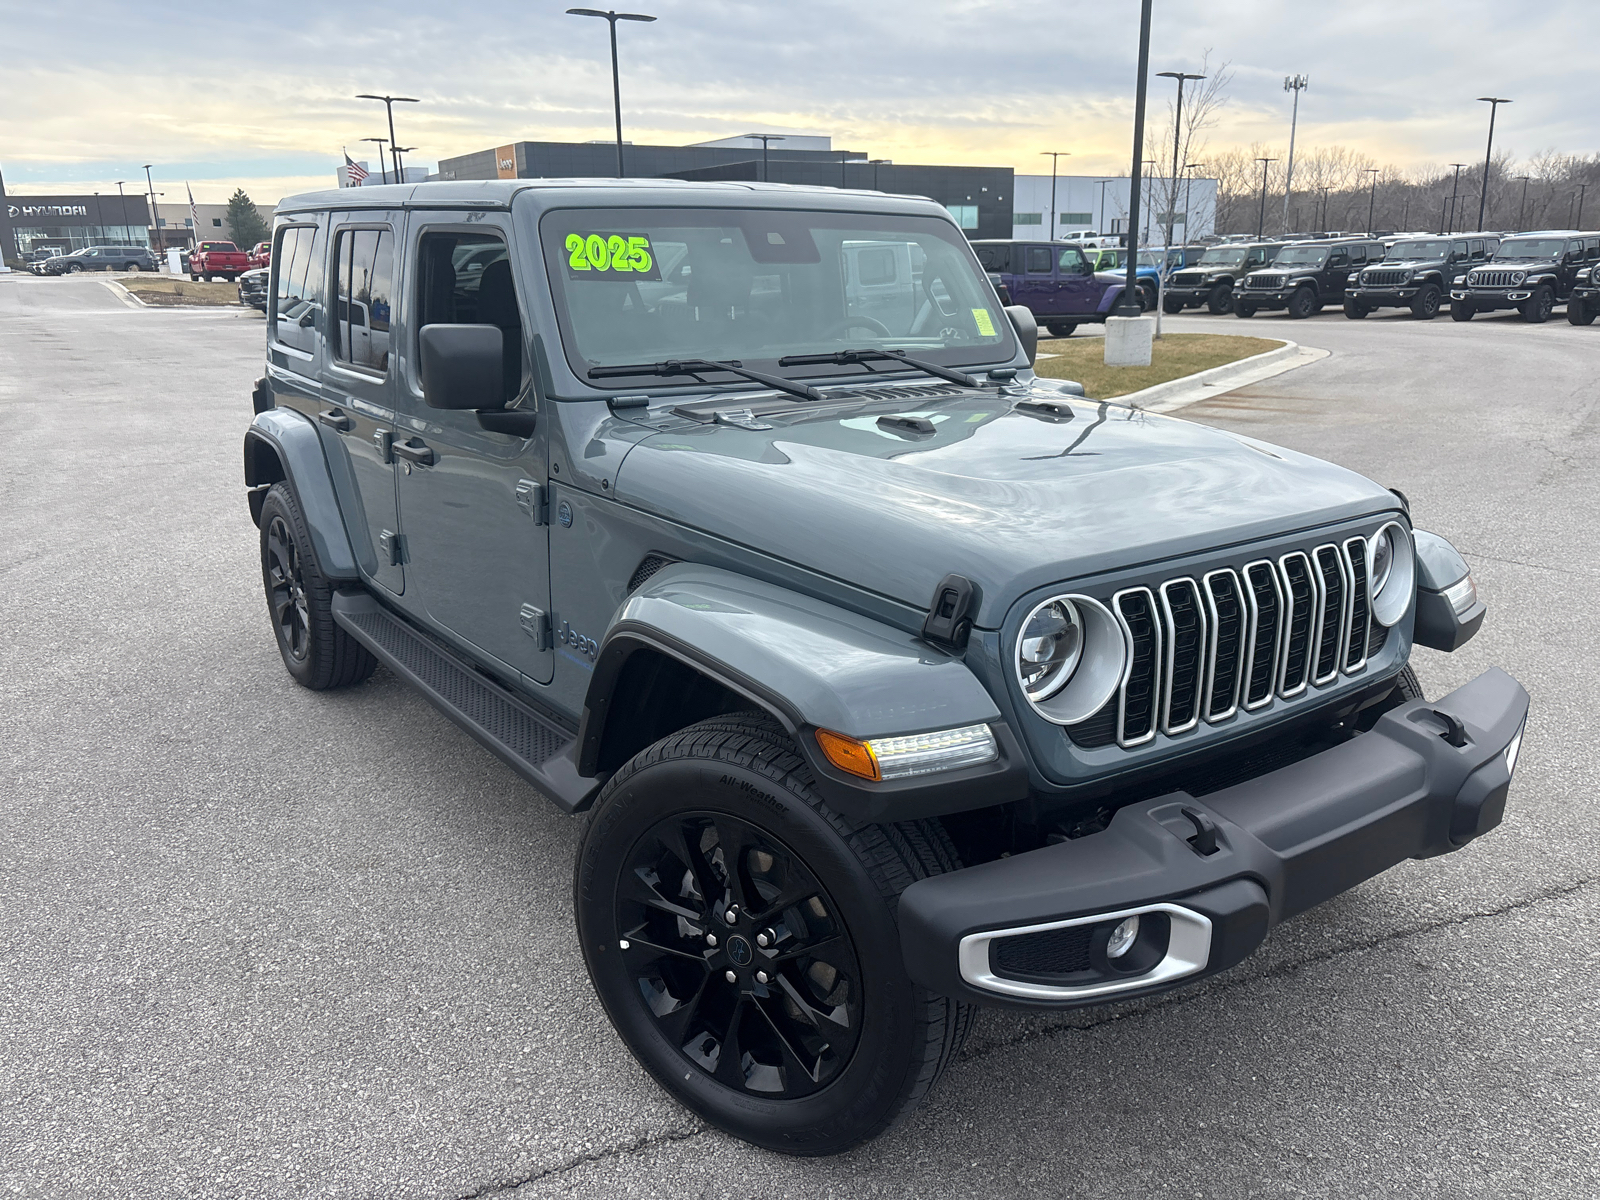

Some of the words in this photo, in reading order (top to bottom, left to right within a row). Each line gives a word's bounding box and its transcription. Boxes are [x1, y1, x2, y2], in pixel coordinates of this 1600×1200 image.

[22, 206, 87, 216] HYUNDAI
[565, 233, 653, 273] 2025
[557, 620, 599, 663] Jeep
[719, 774, 790, 813] All-Weather
